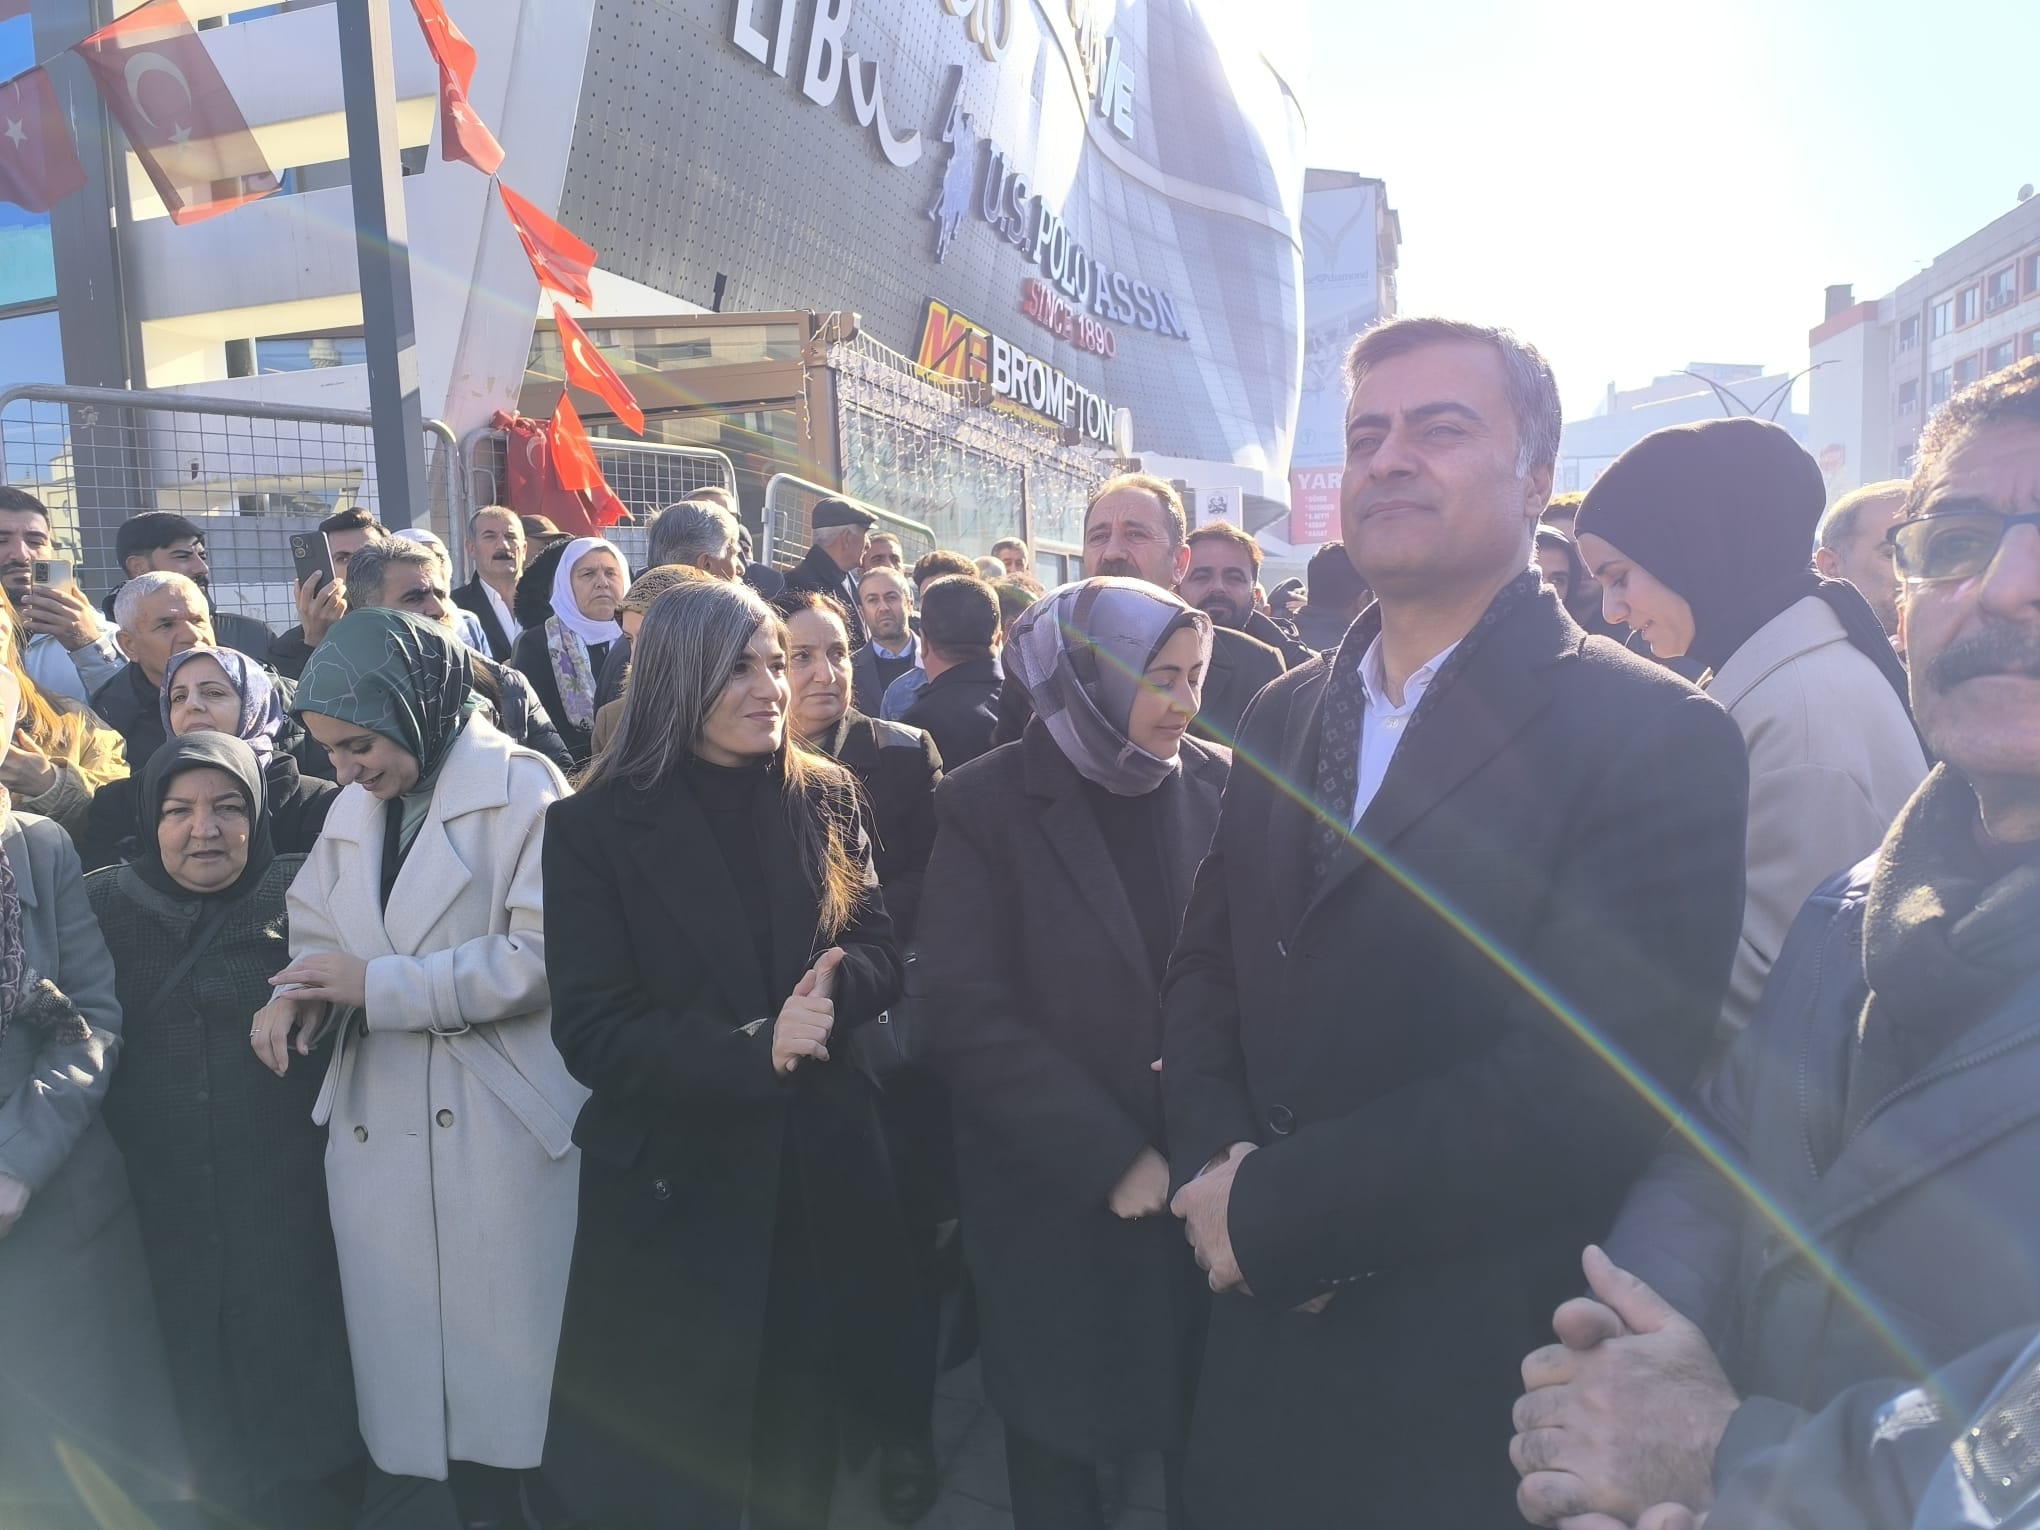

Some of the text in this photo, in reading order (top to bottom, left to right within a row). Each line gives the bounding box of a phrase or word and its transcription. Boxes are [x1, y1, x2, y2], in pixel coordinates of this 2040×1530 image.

[1033, 200, 1090, 301] POLO
[1027, 279, 1117, 358] SINCE 1890
[991, 334, 1113, 445] BROMPTON
